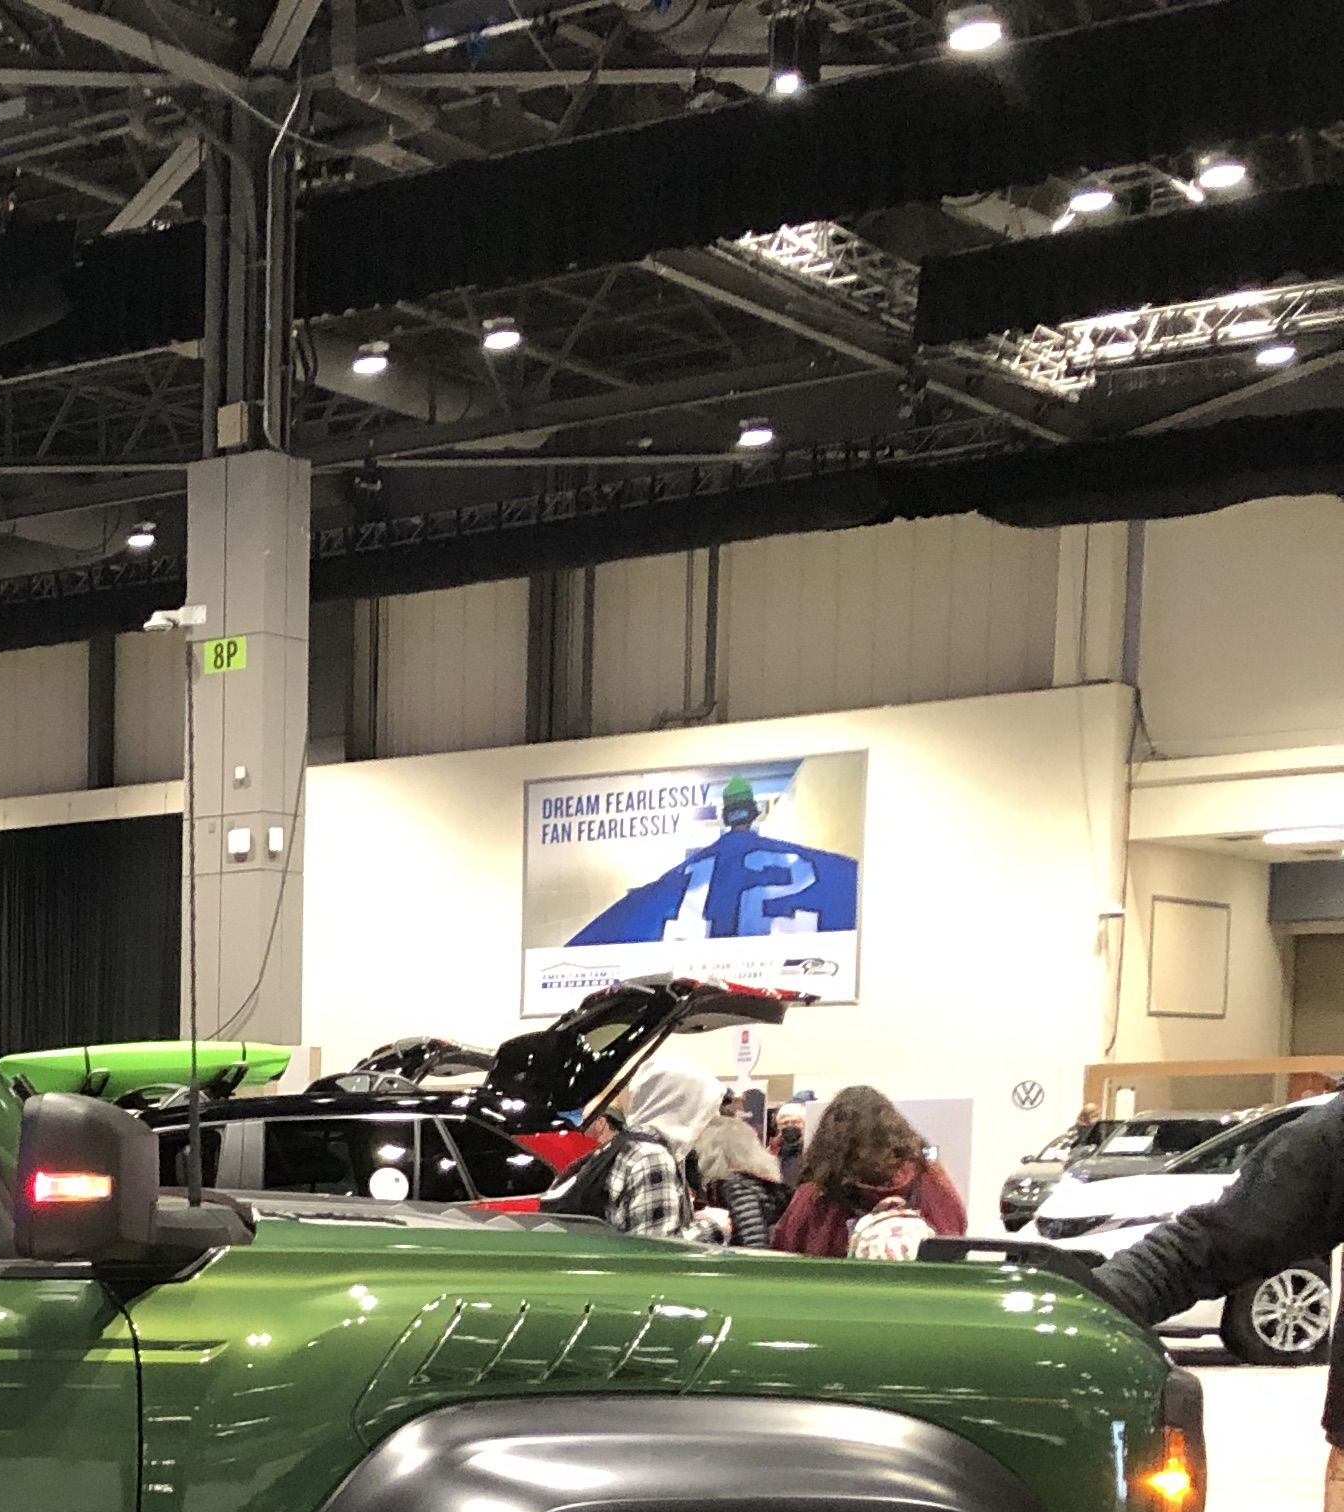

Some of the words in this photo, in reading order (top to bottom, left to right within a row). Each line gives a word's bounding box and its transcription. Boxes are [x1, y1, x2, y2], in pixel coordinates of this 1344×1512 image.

[213, 640, 238, 670] 8P
[542, 794, 600, 819] DREAM
[542, 822, 571, 844] FAN
[577, 814, 680, 841] FEARLESSLY
